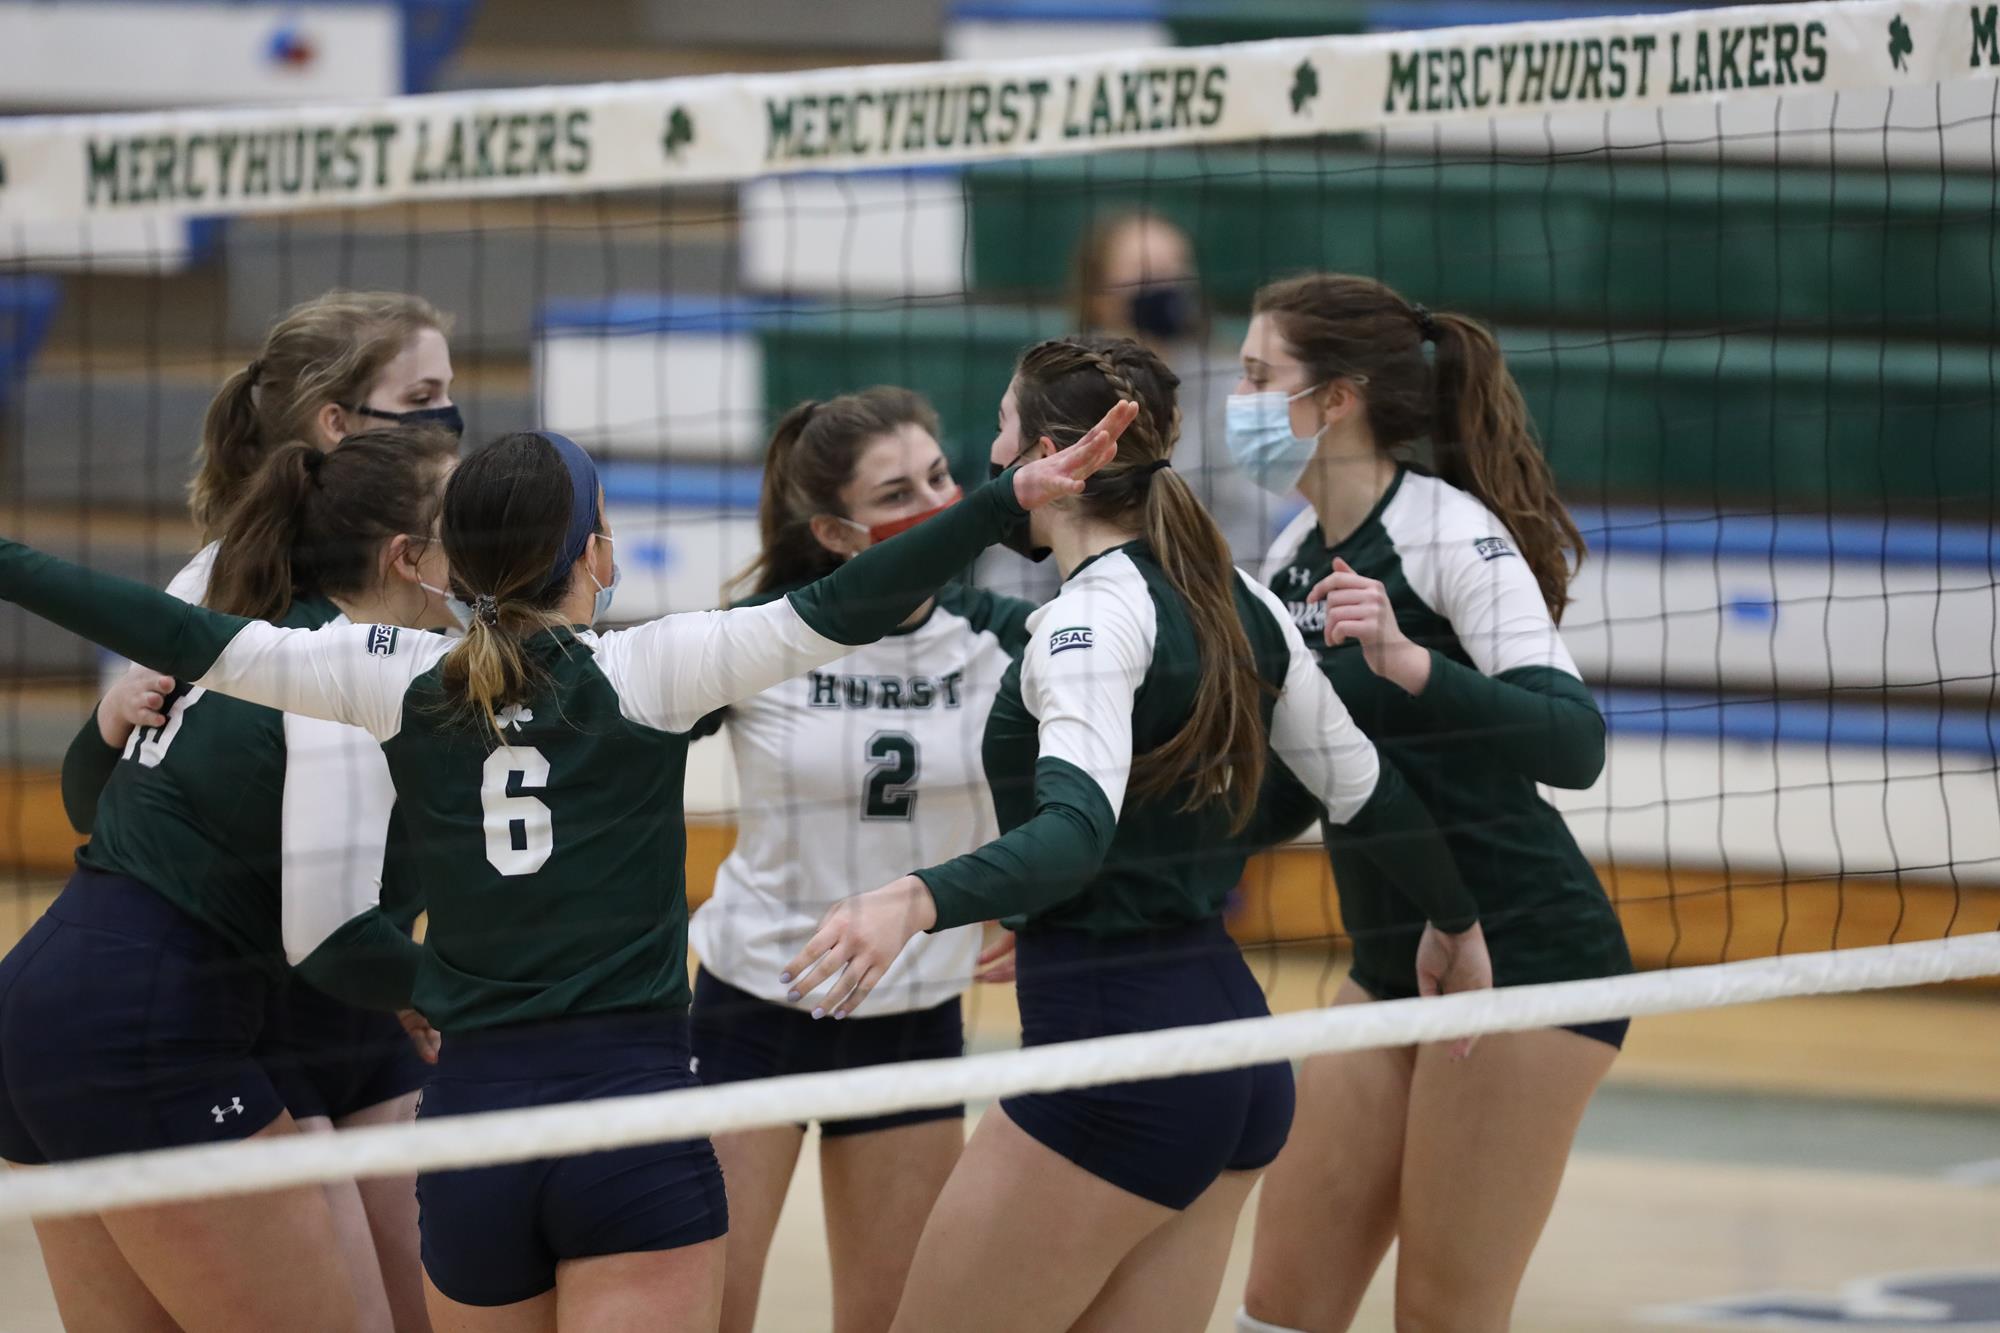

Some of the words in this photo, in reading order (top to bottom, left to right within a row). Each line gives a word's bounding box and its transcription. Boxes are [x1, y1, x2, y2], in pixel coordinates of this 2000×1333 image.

[764, 76, 1051, 161] MERCYHURST
[1062, 64, 1228, 138] LAKERS
[1384, 34, 1656, 113] MERCYHURST
[1669, 21, 1827, 95] LAKERS
[86, 122, 397, 206] MERCYHURST
[410, 111, 592, 184] LAKERS
[1050, 631, 1093, 650] PSAC
[808, 668, 964, 710] HURST
[480, 745, 554, 877] 6
[860, 729, 921, 823] 2
